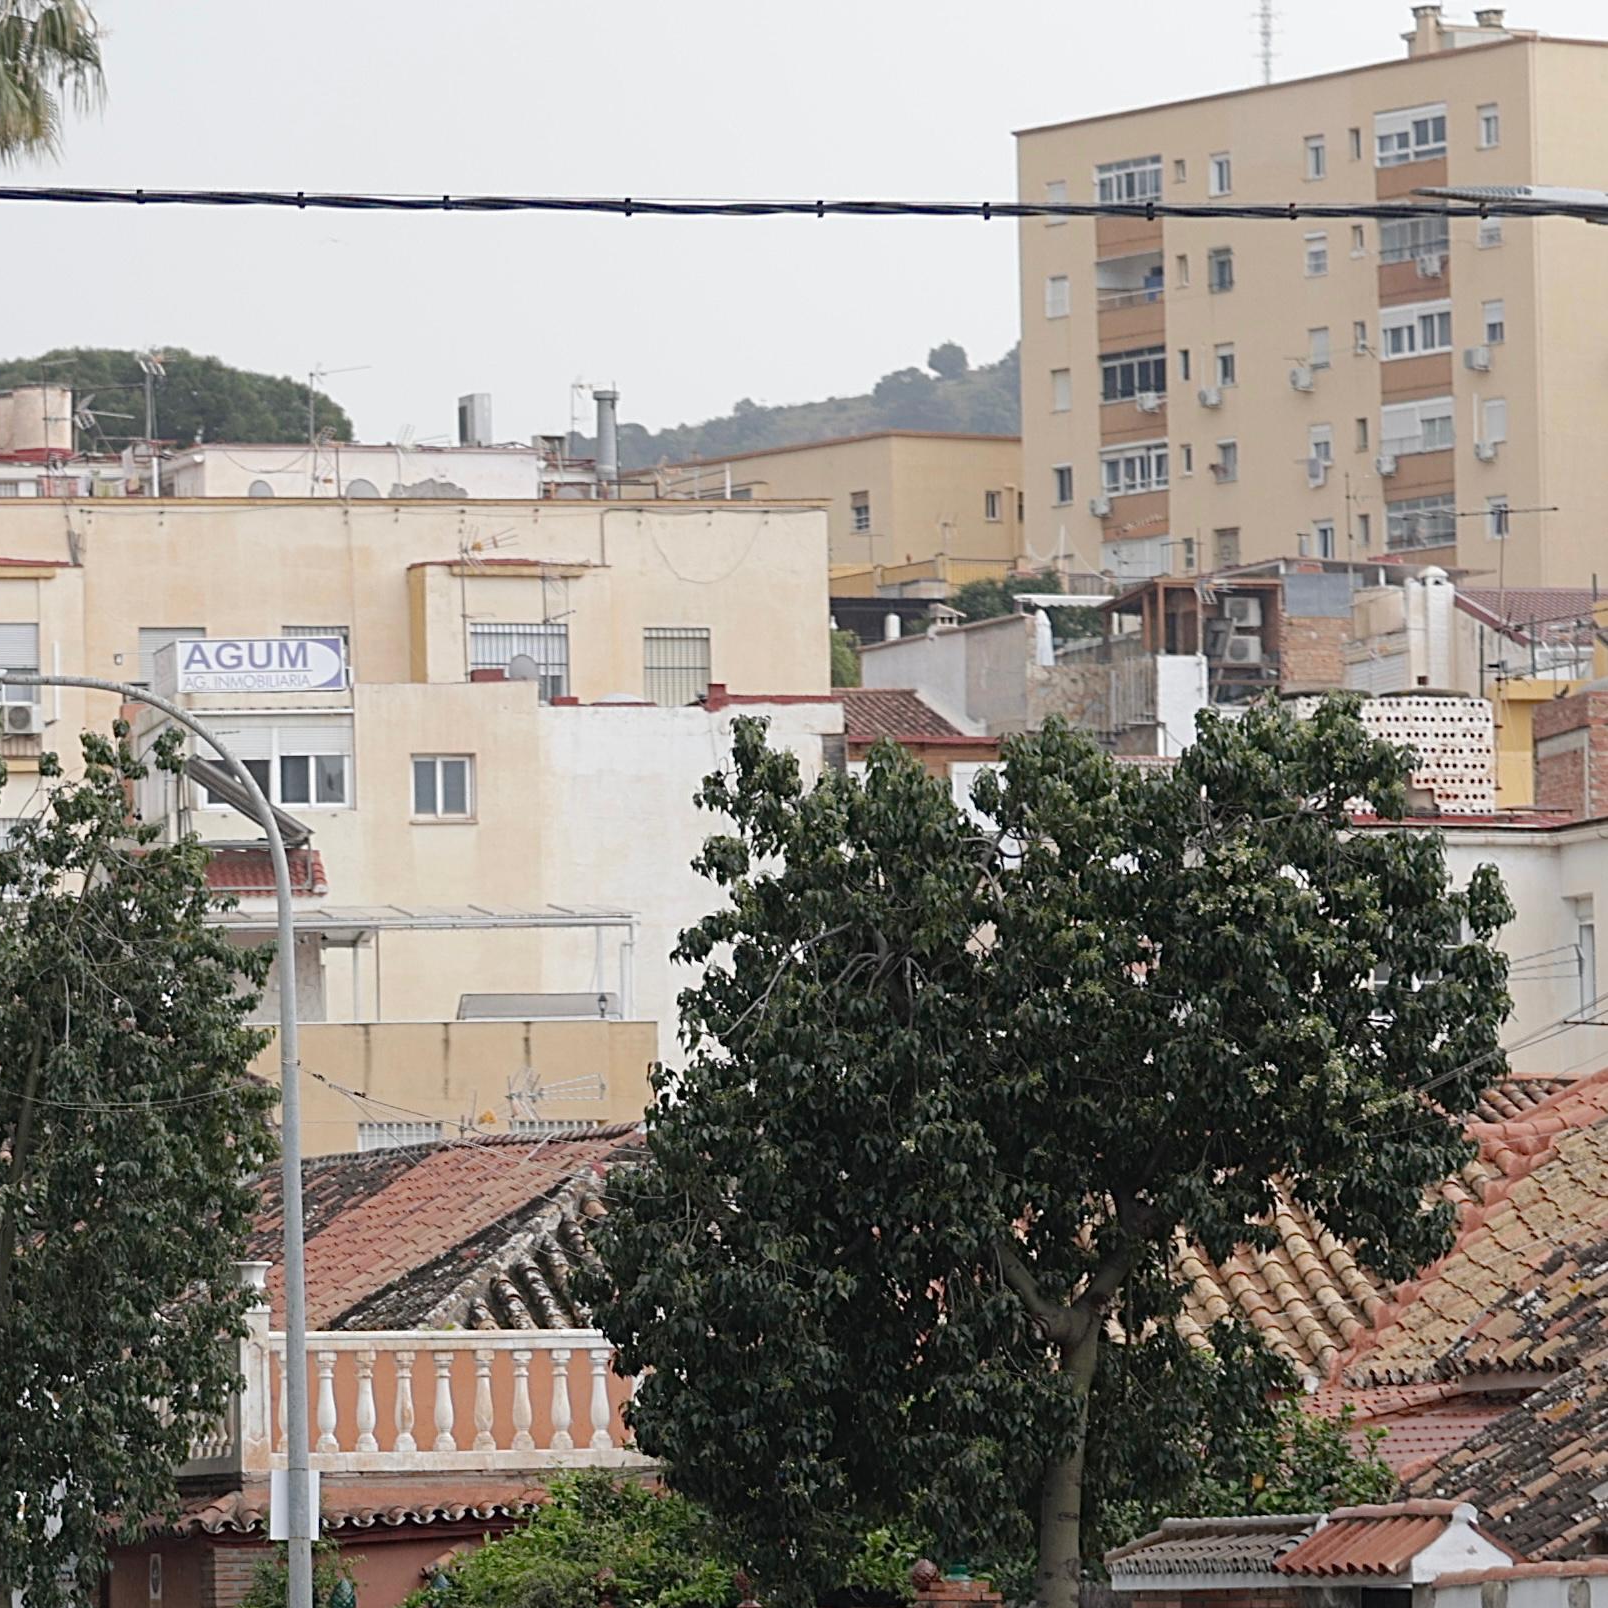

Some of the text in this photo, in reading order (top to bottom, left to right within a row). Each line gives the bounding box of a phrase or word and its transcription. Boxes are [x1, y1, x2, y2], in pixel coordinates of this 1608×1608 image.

[184, 641, 310, 671] AGUM
[185, 674, 312, 690] AG. INMOBILIARIA
